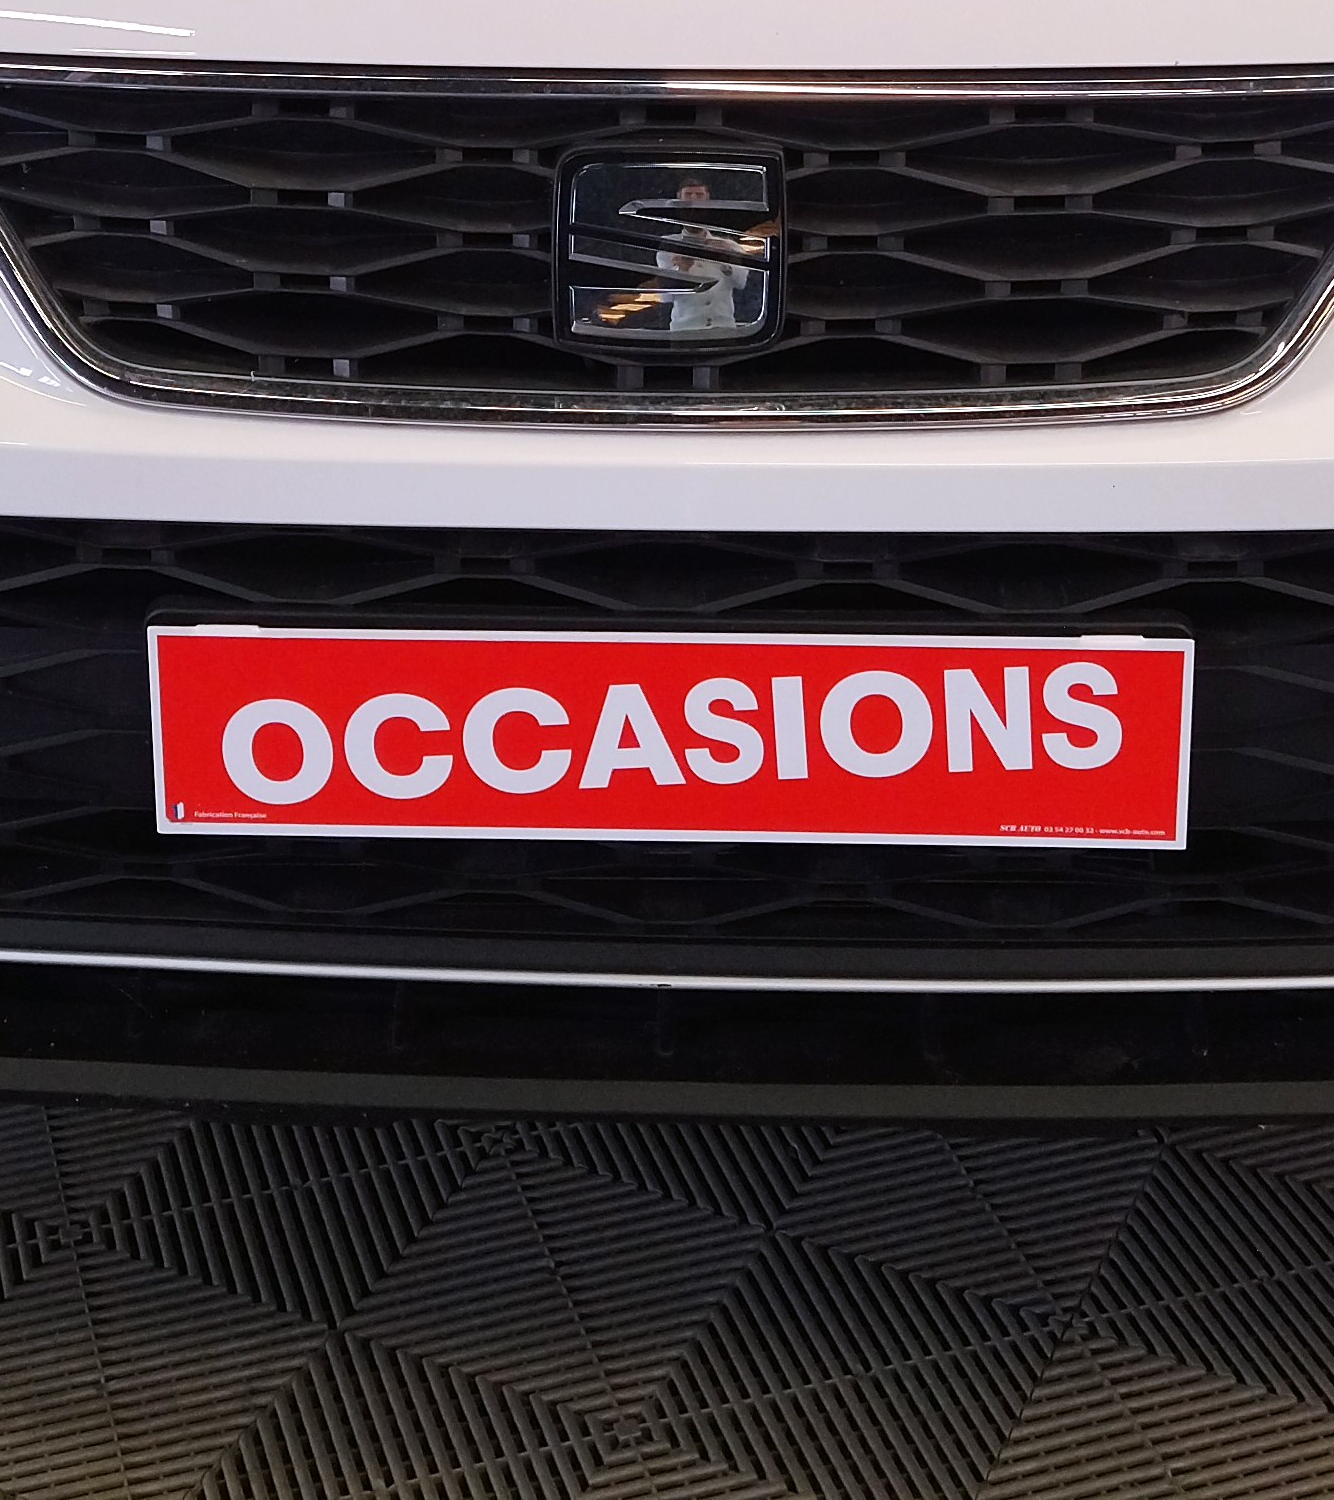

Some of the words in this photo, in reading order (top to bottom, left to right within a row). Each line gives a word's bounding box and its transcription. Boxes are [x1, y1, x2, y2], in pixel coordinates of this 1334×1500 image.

[222, 662, 1122, 804] OCCASIONS
[194, 811, 234, 819] Fabrication
[234, 811, 267, 820] Française
[1019, 825, 1042, 833] AUTO
